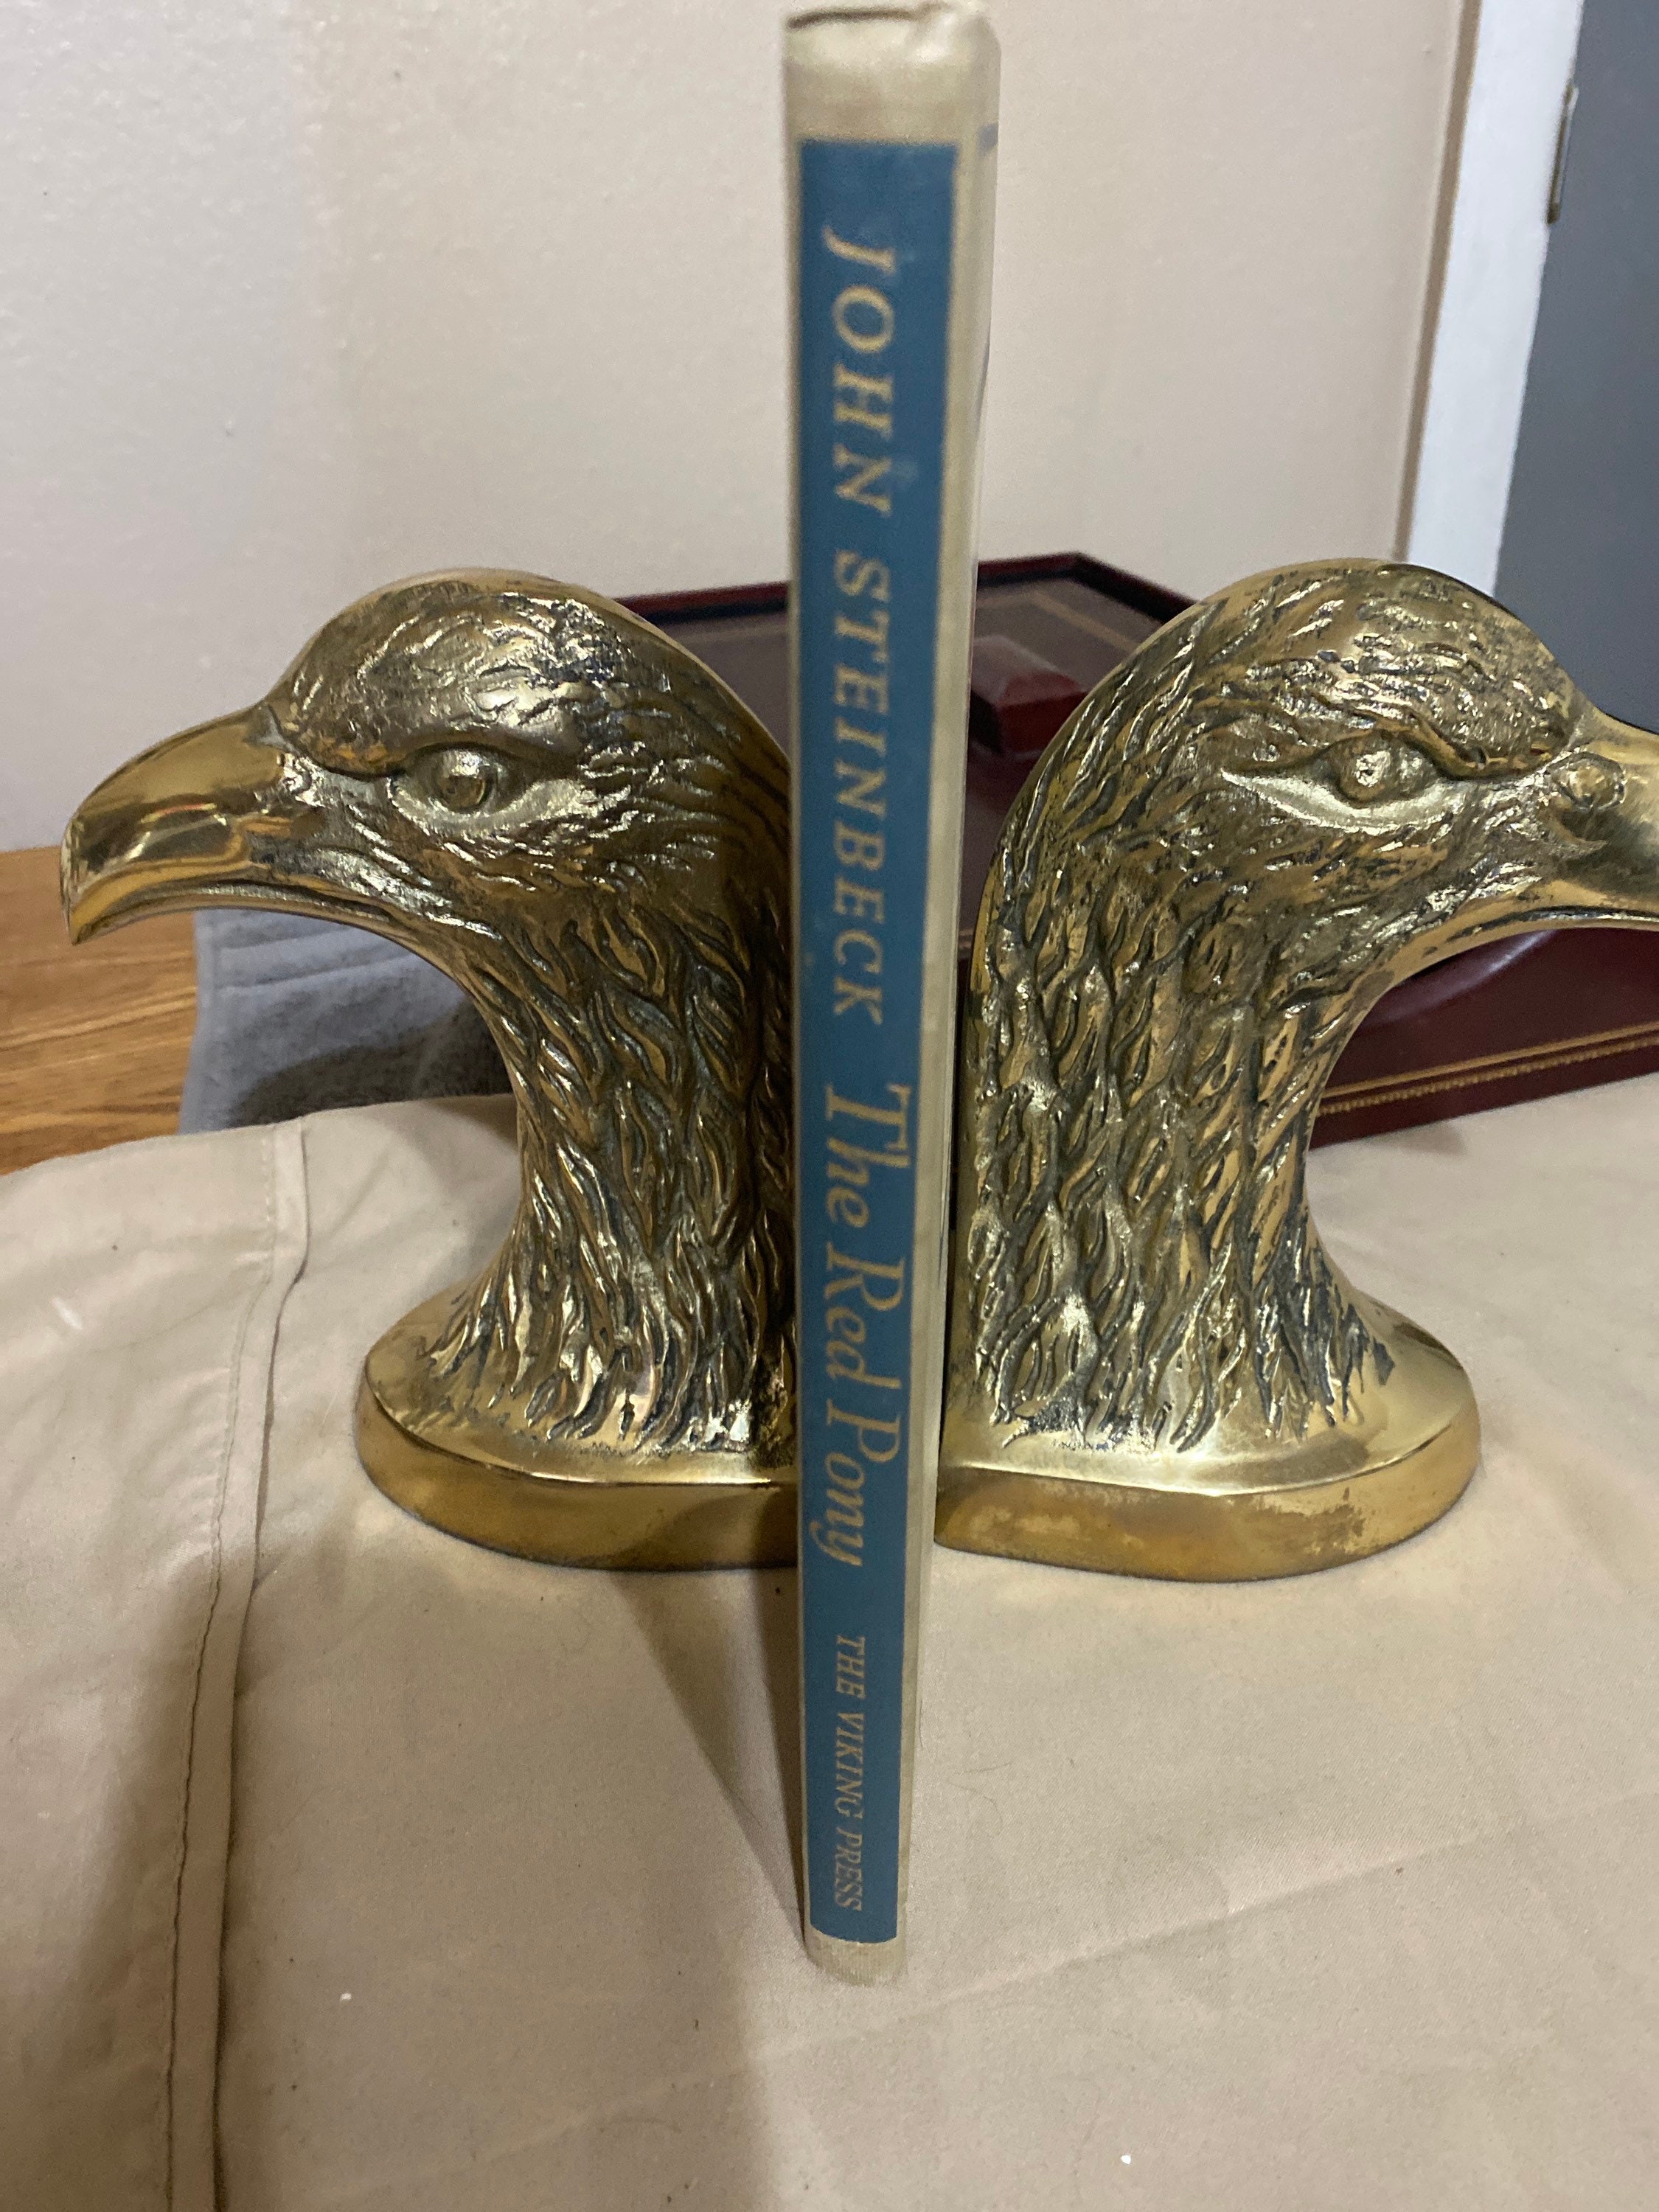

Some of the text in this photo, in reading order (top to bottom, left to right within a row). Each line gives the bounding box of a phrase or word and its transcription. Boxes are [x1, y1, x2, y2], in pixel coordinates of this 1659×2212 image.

[822, 225, 895, 1026] JOHN STEINBECK
[810, 1082, 913, 1568] The Red Pony
[833, 1635, 866, 1912] THE VIKING PRESS
